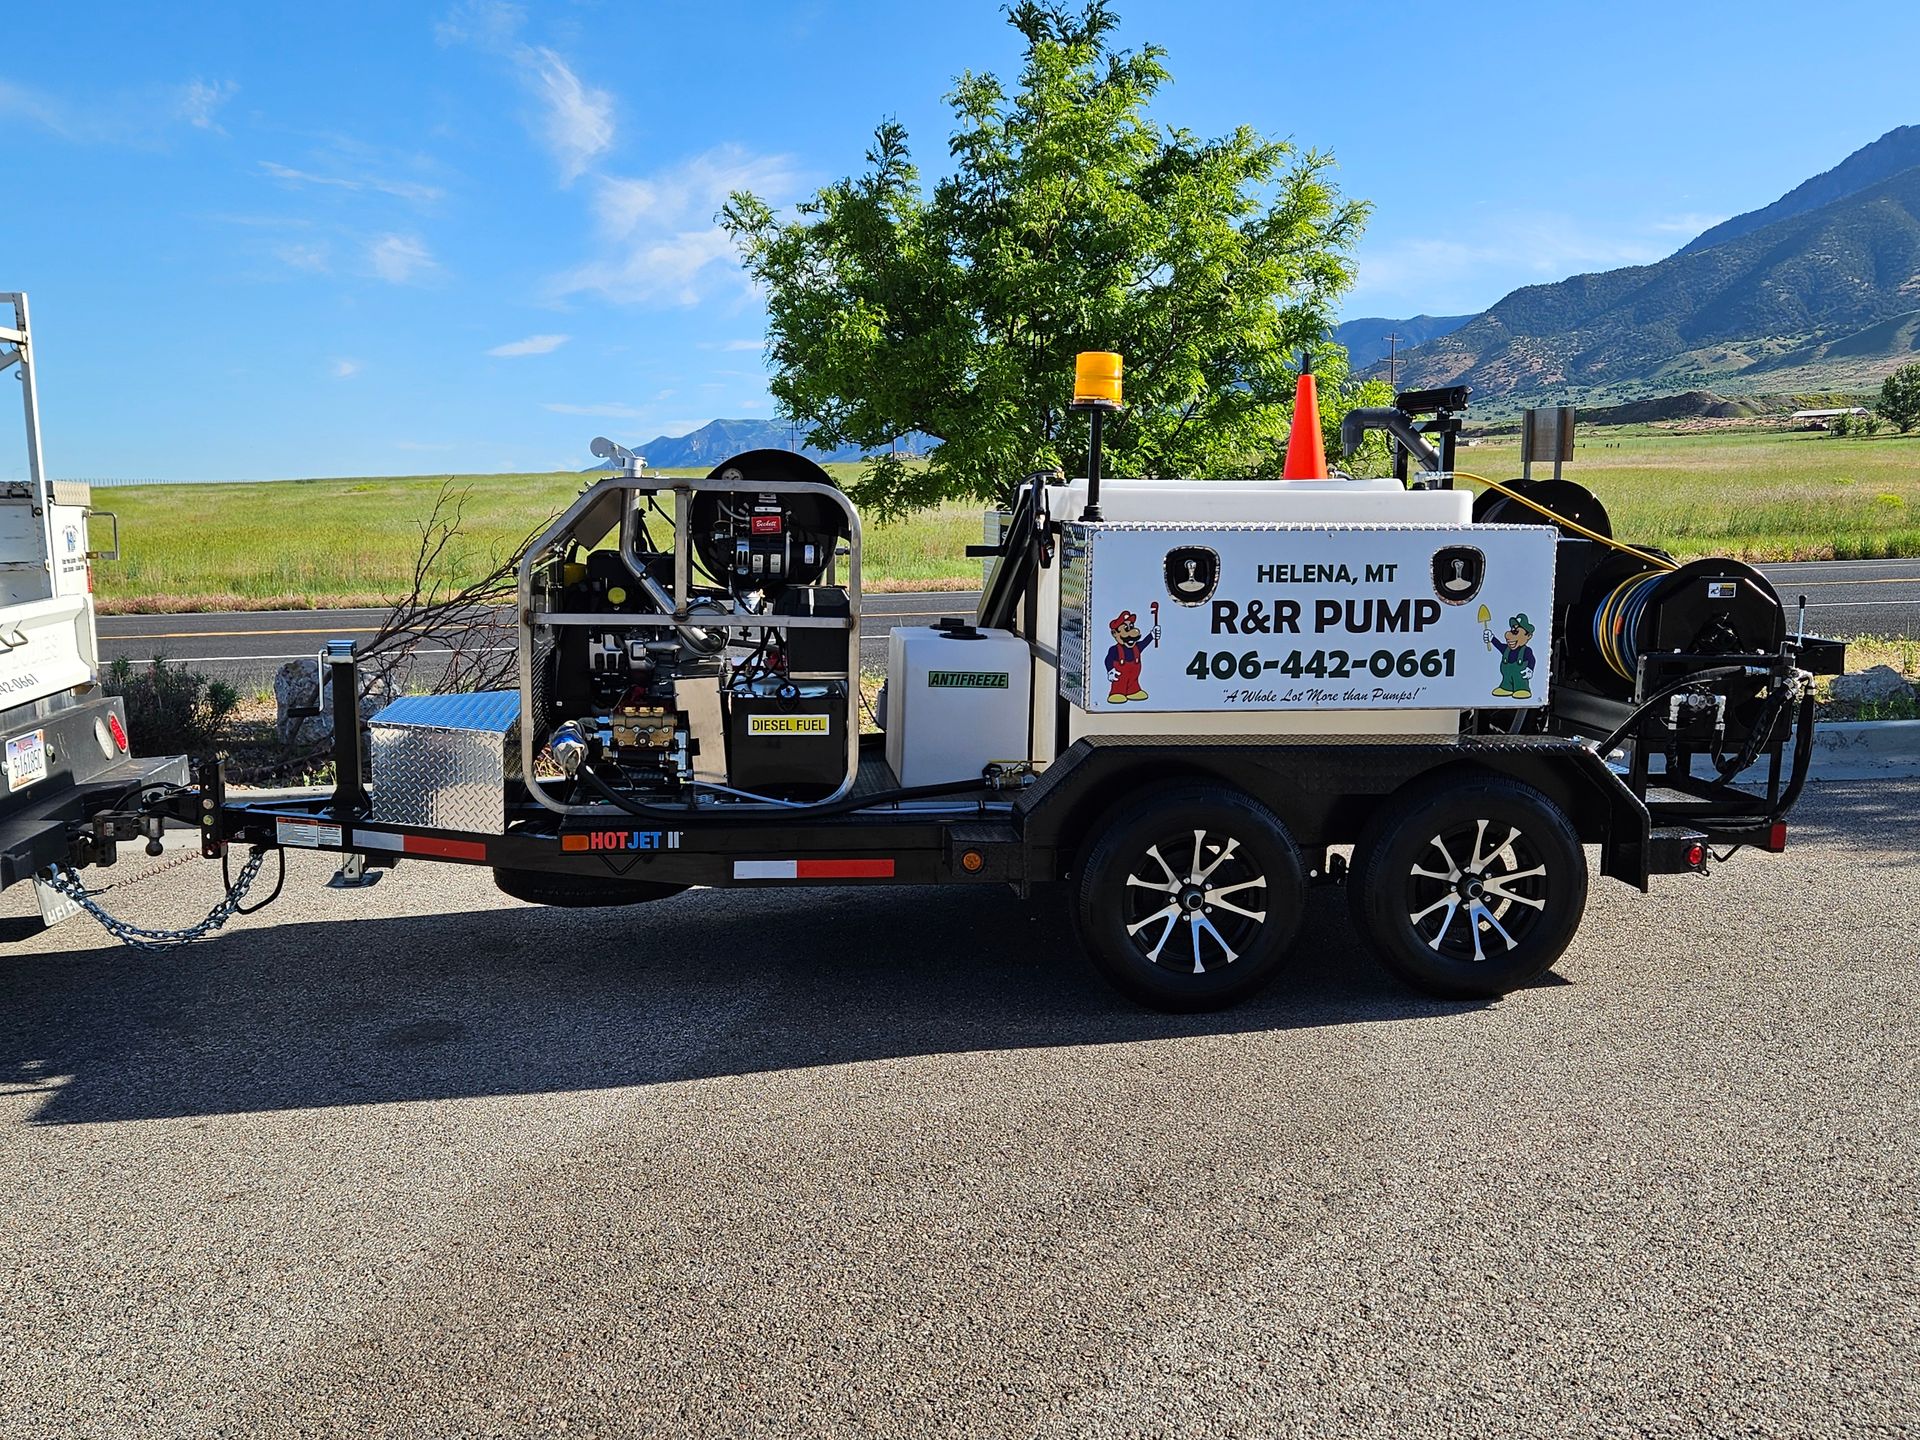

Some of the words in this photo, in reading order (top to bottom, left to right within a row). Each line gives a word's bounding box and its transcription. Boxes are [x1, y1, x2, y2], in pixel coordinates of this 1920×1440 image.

[1257, 564, 1358, 586] HELENA,
[1365, 564, 1398, 583] MT
[1210, 600, 1301, 634] R&R
[1314, 599, 1442, 633] PUMP
[1186, 649, 1456, 680] 406-442-0661
[931, 673, 1006, 686] ANTIFREEZE
[1241, 690, 1277, 702] Whole
[1281, 689, 1303, 702] Lot
[1305, 688, 1339, 702] More
[1343, 689, 1368, 701] than
[752, 719, 792, 731] DIESEL
[796, 719, 825, 731] FUEL
